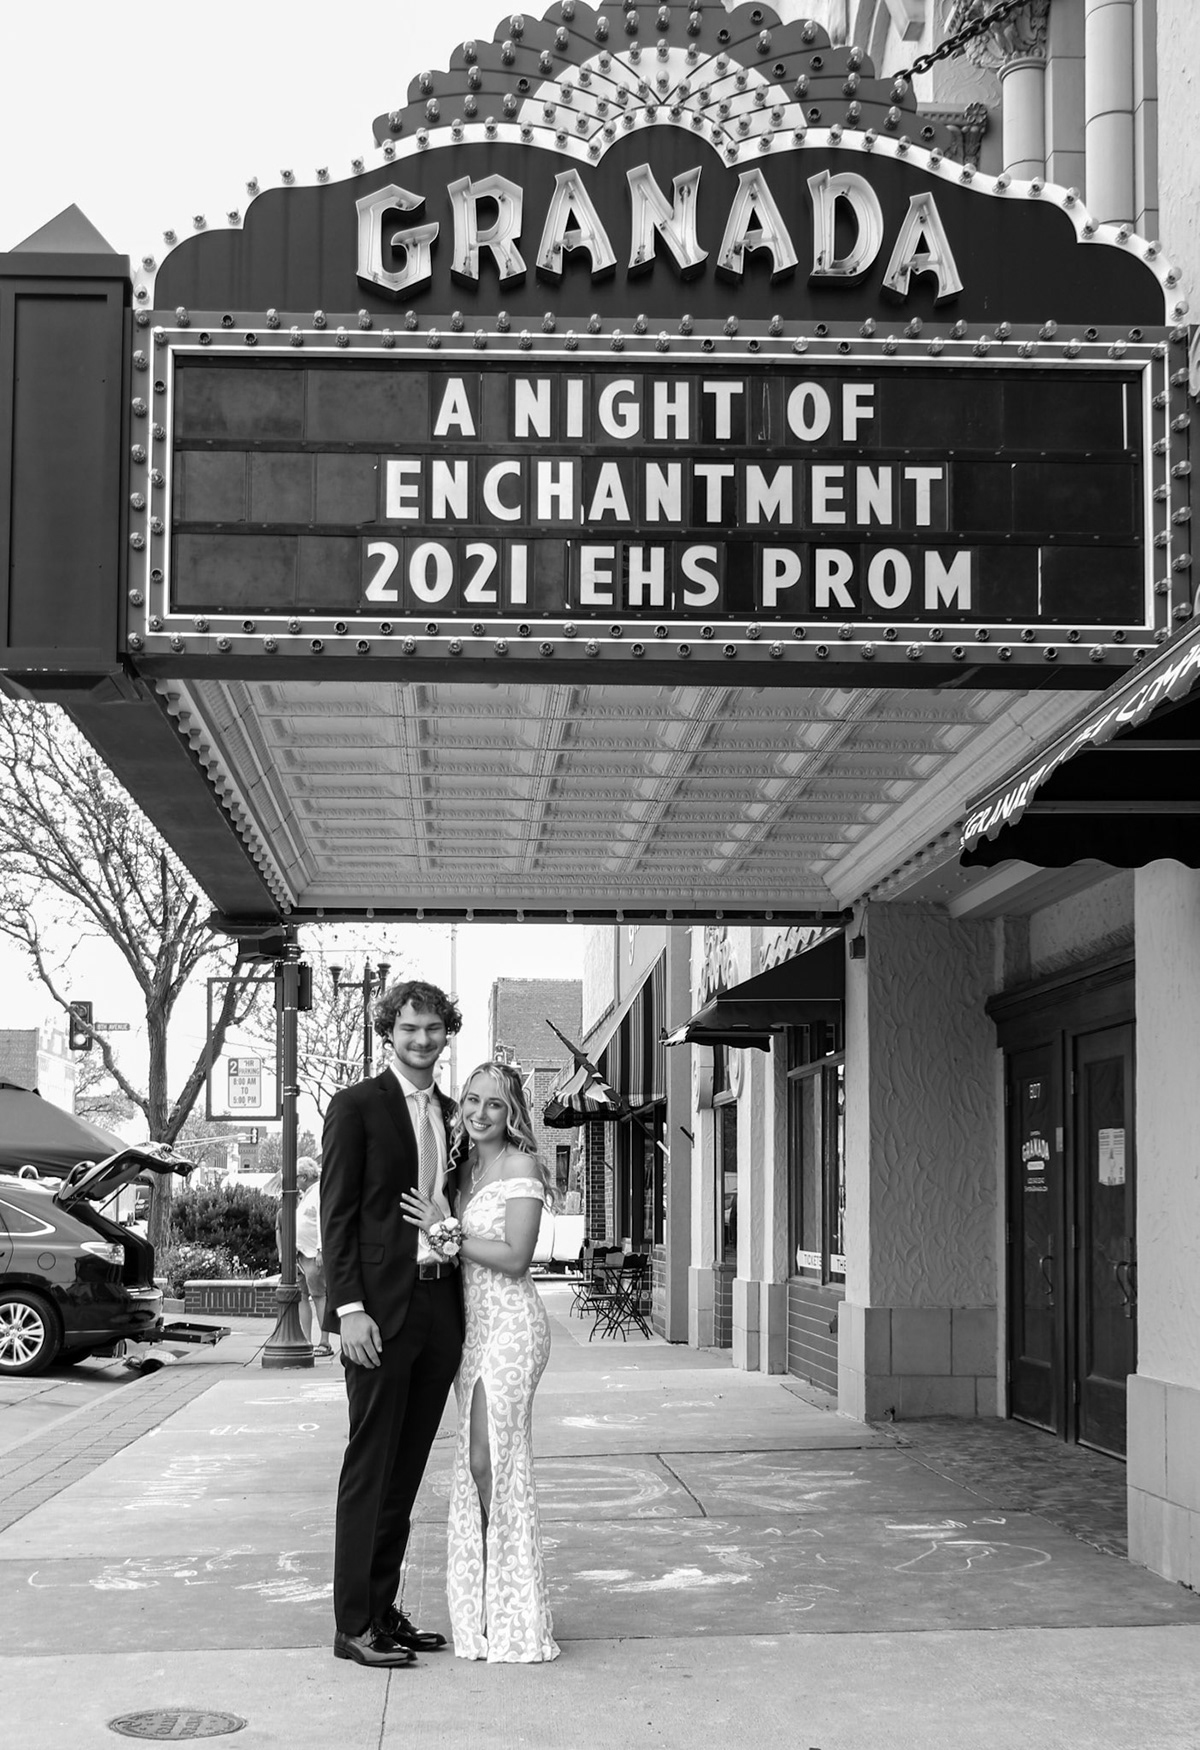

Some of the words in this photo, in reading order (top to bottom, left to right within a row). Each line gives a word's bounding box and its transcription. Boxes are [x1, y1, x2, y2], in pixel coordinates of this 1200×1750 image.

[355, 163, 965, 303] GRANADA
[433, 377, 476, 436] A
[514, 379, 744, 441] NIGHT
[787, 381, 875, 442] OF
[385, 459, 943, 526] ENCHANTMENT
[364, 541, 528, 605] 2021
[580, 545, 720, 608] EHS
[762, 548, 971, 611] PROM
[230, 1061, 237, 1074] 2
[238, 1067, 260, 1075] PARKING
